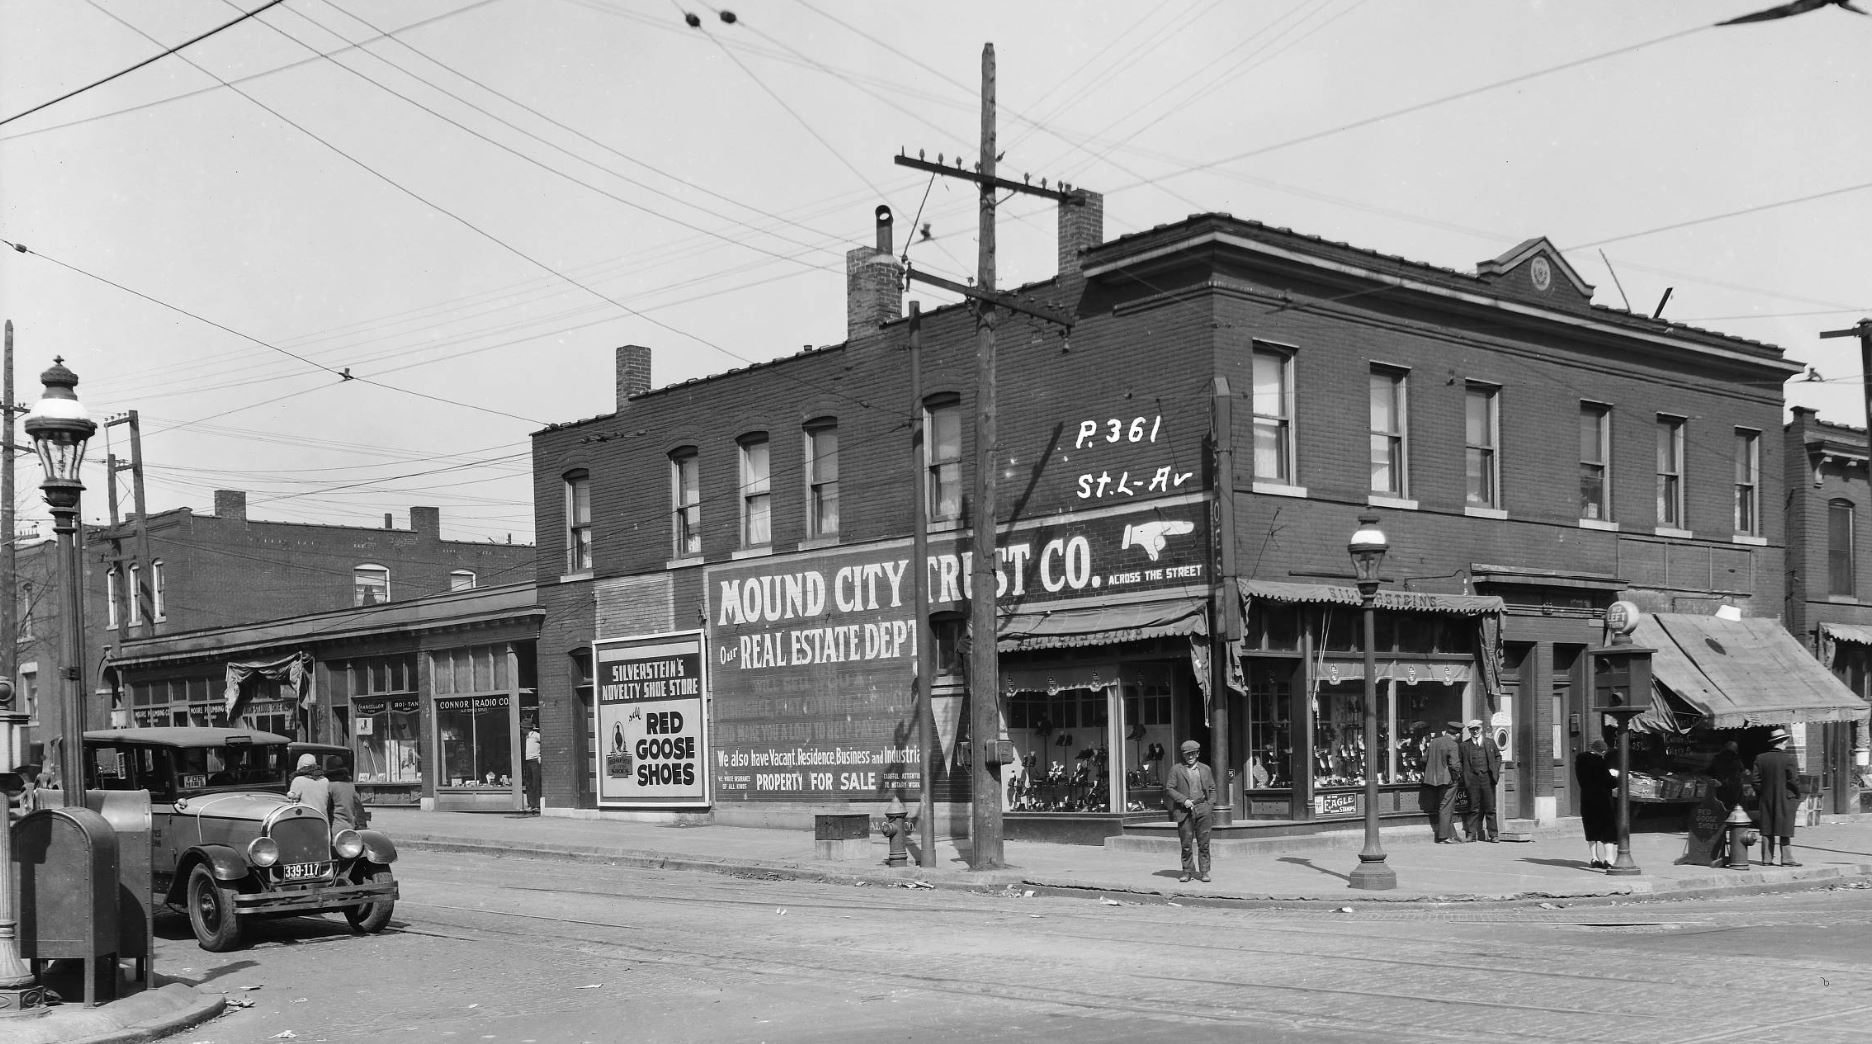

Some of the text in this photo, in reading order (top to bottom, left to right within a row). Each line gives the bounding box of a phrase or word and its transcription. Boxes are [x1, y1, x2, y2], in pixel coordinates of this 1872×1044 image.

[717, 571, 826, 626] MOUND
[835, 560, 909, 613] CITY
[1040, 536, 1101, 593] CO.
[1109, 564, 1203, 586] ACROSS THE STREET
[1327, 587, 1437, 608] SILRSTEIN'S
[1606, 612, 1626, 622] LEFT
[720, 646, 738, 665] Our
[740, 632, 787, 670] REAL
[791, 624, 861, 666] ESTATE
[612, 658, 685, 682] SILVERSTEIN'S
[602, 678, 698, 701] NOVELTY SHOE STORE
[439, 700, 469, 711] CONNOR
[474, 698, 496, 708] RADIO
[646, 711, 684, 735] RED
[636, 736, 695, 760] GOOSE
[717, 750, 729, 767] We
[731, 747, 749, 767] also
[751, 749, 769, 767] have
[836, 746, 870, 765] Business
[871, 750, 883, 765] and
[637, 763, 695, 787] SHOES
[756, 772, 877, 791] PROPERTY FOR SALE
[1323, 794, 1354, 812] EAGLE
[285, 863, 320, 878] 339-117
